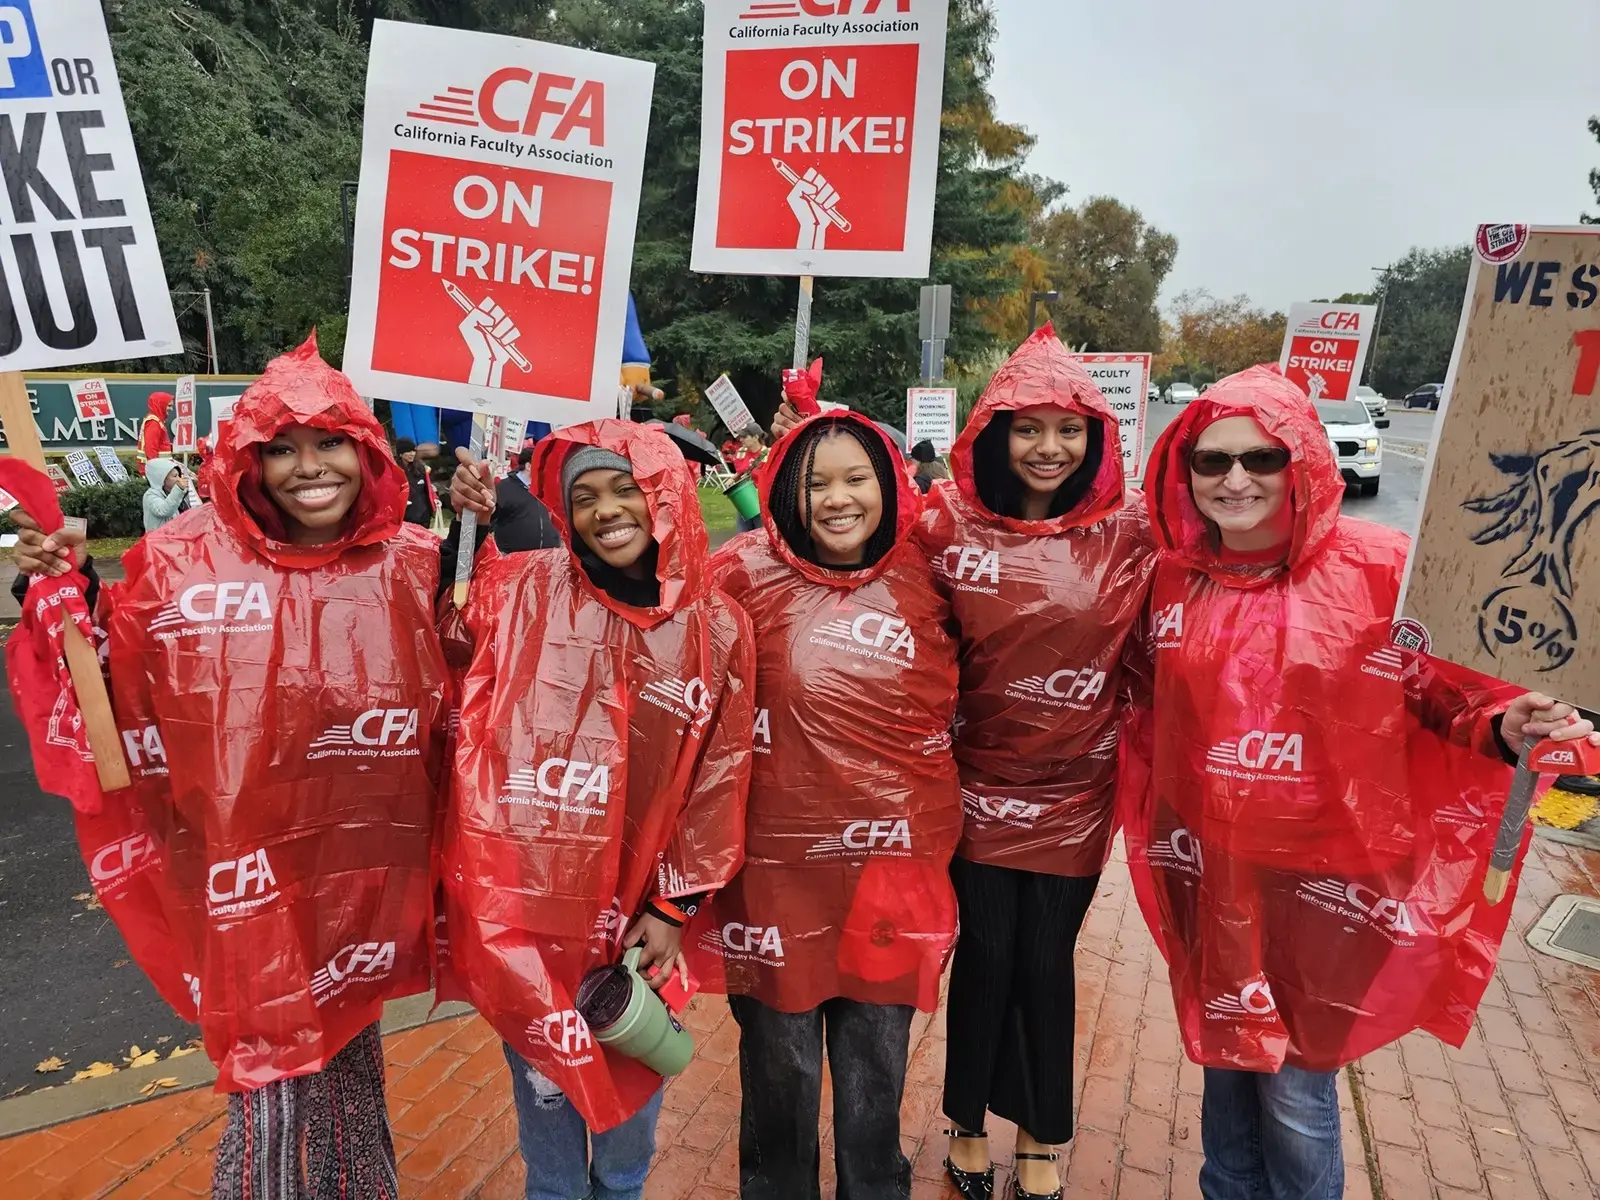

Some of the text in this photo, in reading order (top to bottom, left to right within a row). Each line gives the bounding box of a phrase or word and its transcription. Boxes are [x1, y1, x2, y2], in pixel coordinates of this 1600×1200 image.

[729, 20, 919, 39] California Faculty Association
[51, 58, 100, 96] OR
[780, 58, 857, 101] ON
[478, 67, 604, 147] CFA
[394, 124, 613, 169] California Faculty Association
[728, 117, 906, 156] STRIKE!
[453, 175, 543, 228] ON
[1490, 234, 1516, 250] STRIKE!
[389, 228, 596, 295] STRIKE!
[1494, 261, 1560, 307] WE
[1320, 311, 1360, 331] CFA
[1310, 340, 1339, 355] ON
[1288, 356, 1353, 373] STRIKE!
[84, 381, 102, 390] CFA
[1099, 386, 1132, 395] RKING
[47, 466, 59, 476] FA
[67, 450, 83, 463] CSU
[942, 545, 1000, 584] CFA
[58, 587, 78, 596] CFA
[180, 582, 272, 622] CFA
[957, 584, 998, 594] Association
[182, 626, 217, 638] Faculty
[219, 624, 273, 633] Association
[852, 612, 915, 659] CFA
[810, 636, 912, 669] California Faculty Association
[1044, 668, 1107, 701] CFA
[1360, 664, 1398, 682] California
[639, 690, 675, 713] California
[1004, 689, 1092, 711] California Faculty Associati
[352, 708, 418, 746] CFA
[122, 725, 167, 767] FA
[306, 748, 346, 760] California
[347, 748, 379, 758] Faculty
[1238, 730, 1303, 772] CFA
[1551, 750, 1574, 763] CFA
[536, 757, 608, 804] CFA
[1232, 770, 1256, 782] Faculty
[1256, 773, 1300, 782] Association
[532, 798, 559, 812] Faculty
[560, 803, 606, 816] Association
[978, 796, 1040, 820] CFA
[842, 820, 912, 849] CFA
[805, 852, 840, 860] California
[870, 850, 912, 858] Association
[98, 876, 128, 895] Faculty
[208, 848, 276, 903] CFA
[1296, 890, 1415, 946] California Faculty Association
[1346, 882, 1418, 936] CFA
[722, 922, 784, 958] CFA
[328, 942, 396, 982] CFA
[698, 942, 785, 968] California Faculty Association
[542, 1010, 592, 1054] CFA
